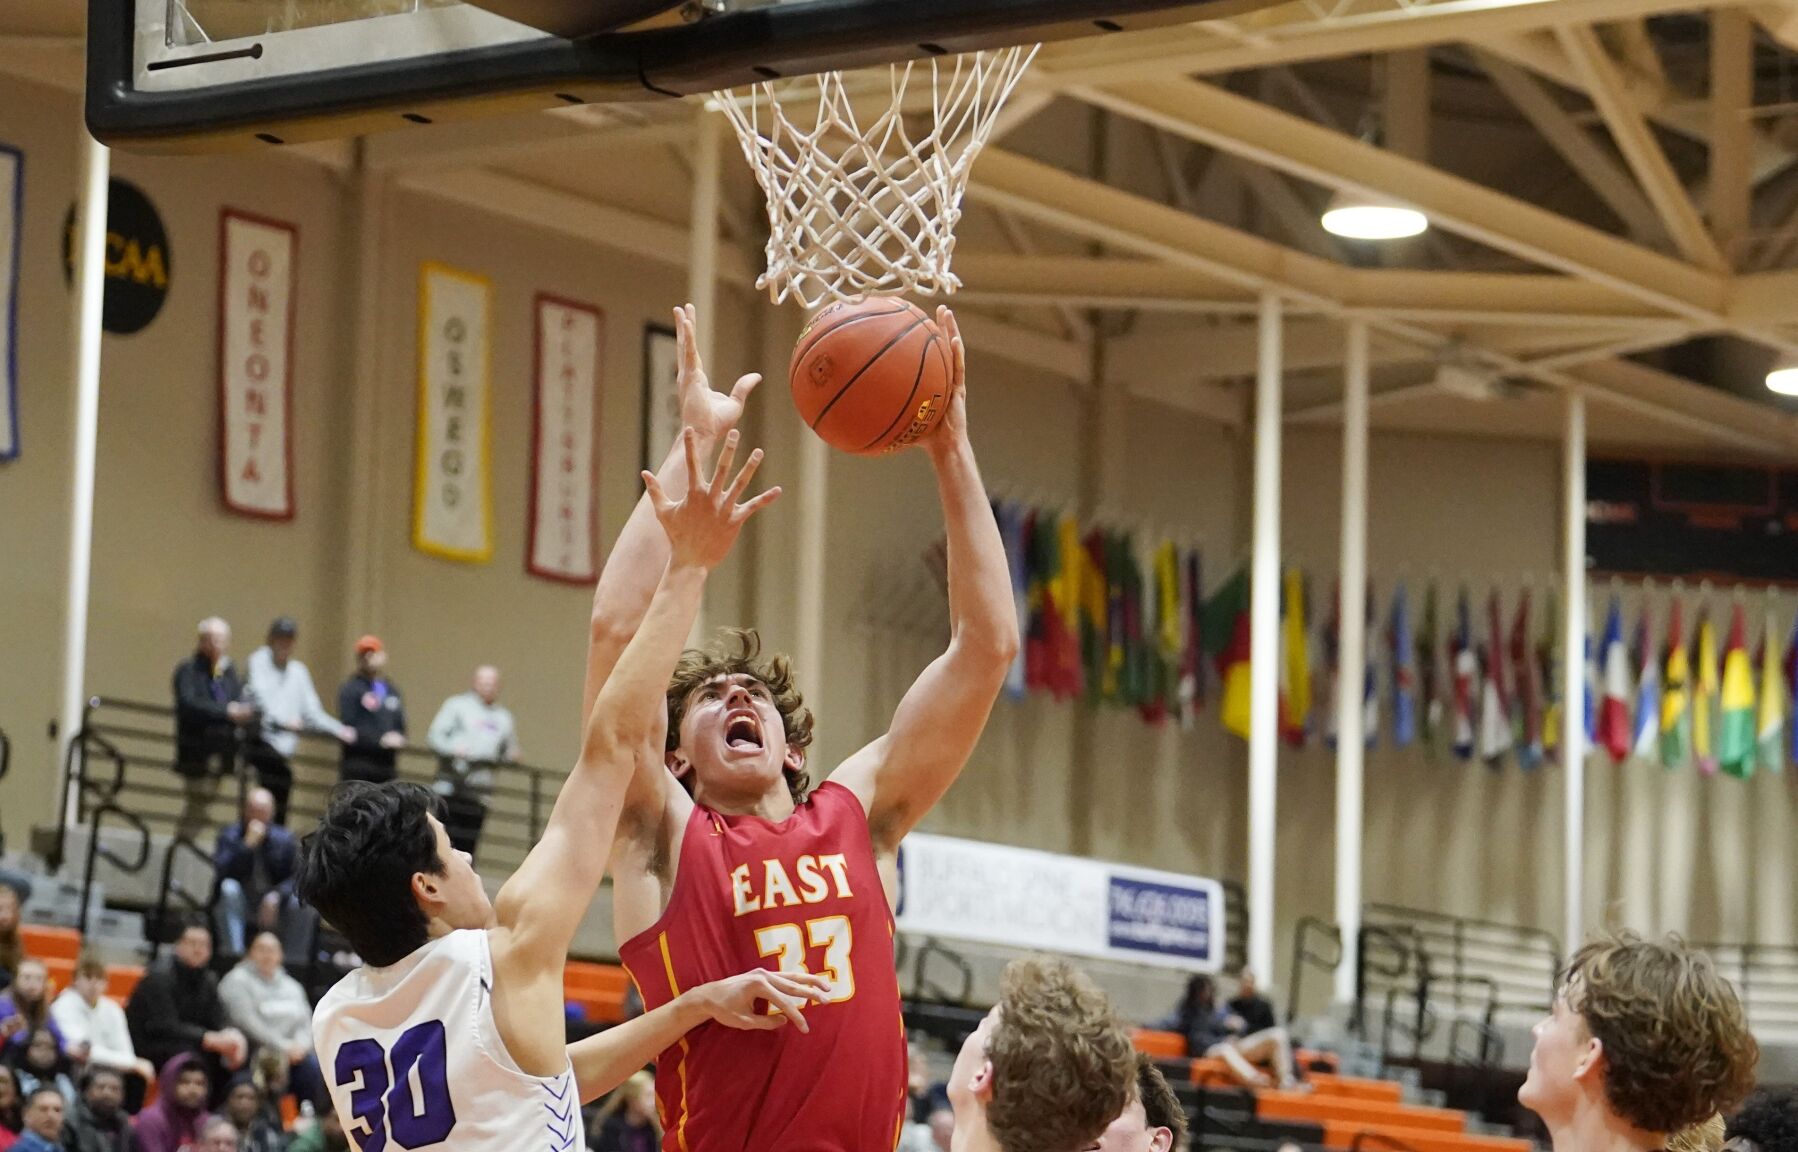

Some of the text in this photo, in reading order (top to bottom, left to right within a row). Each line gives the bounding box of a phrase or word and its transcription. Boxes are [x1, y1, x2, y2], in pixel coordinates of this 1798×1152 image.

[240, 249, 271, 484] ONEONTA
[730, 853, 854, 917] EAST
[753, 914, 856, 1016] 33
[334, 1018, 457, 1152] 30
